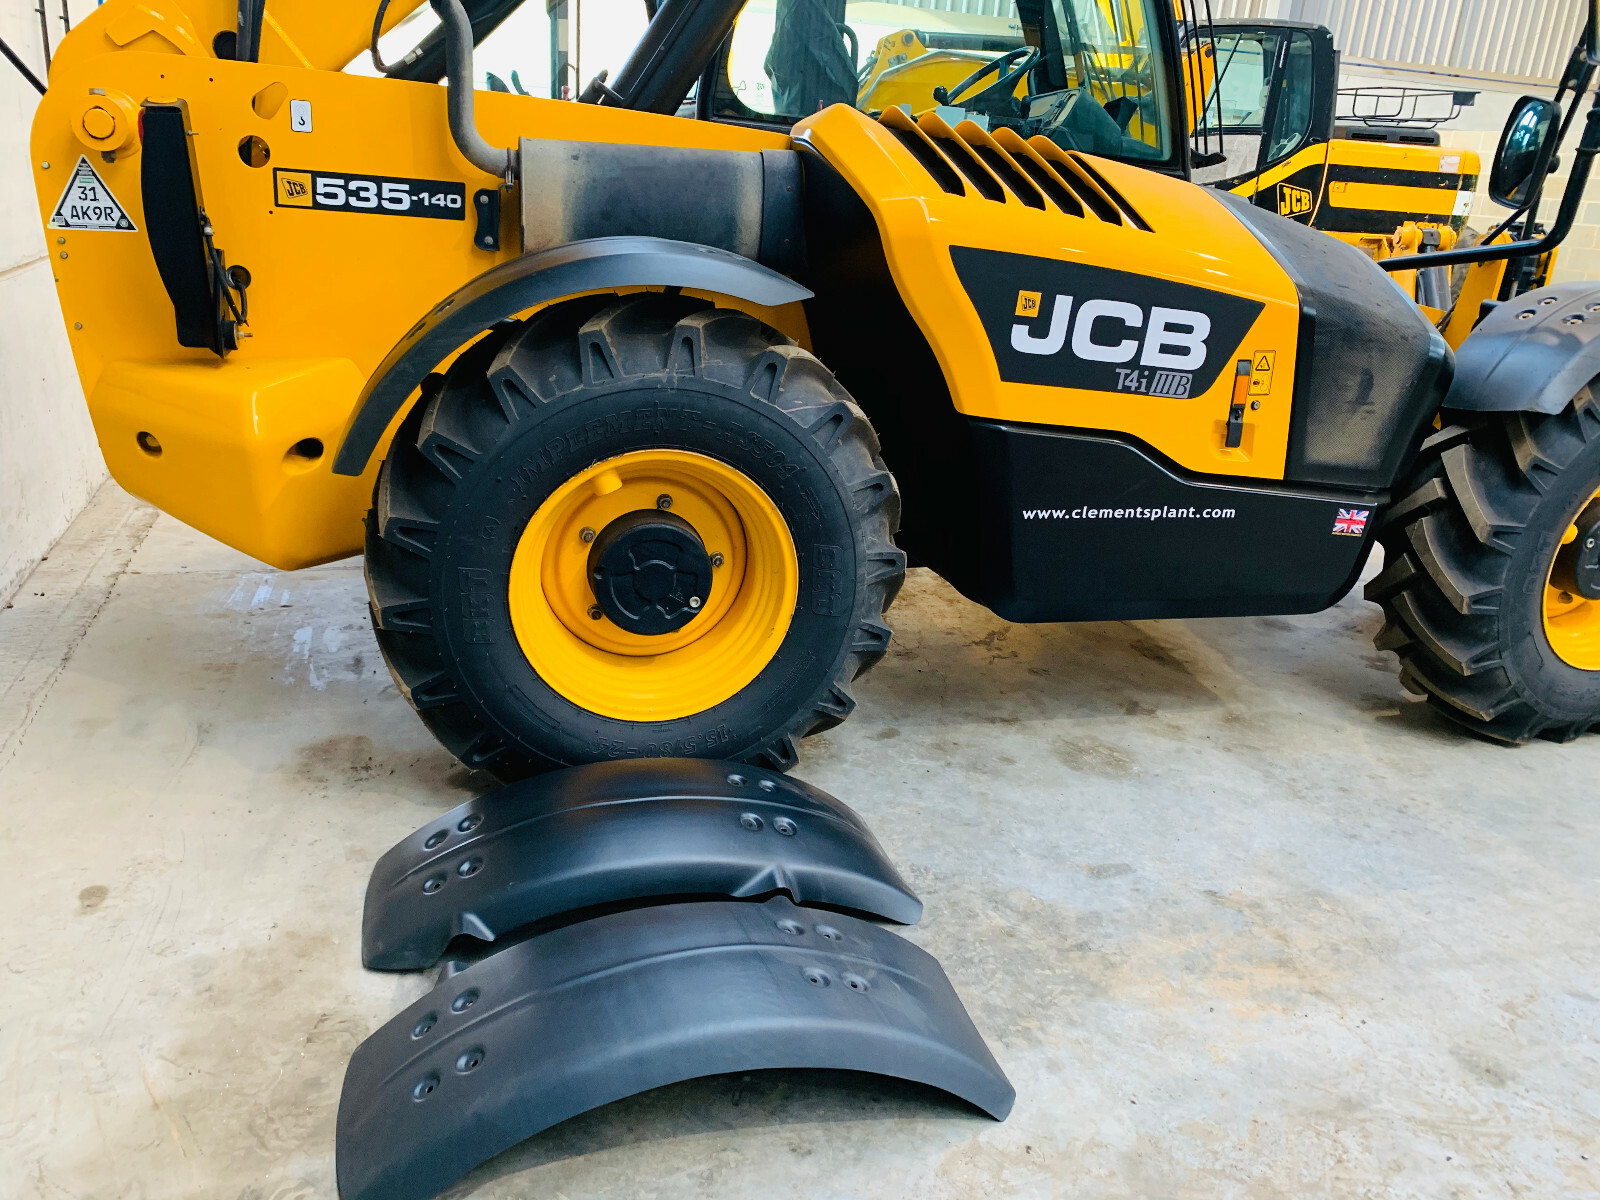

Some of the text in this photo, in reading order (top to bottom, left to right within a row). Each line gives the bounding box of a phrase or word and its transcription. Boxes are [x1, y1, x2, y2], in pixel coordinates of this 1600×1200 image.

[77, 185, 99, 202] 31
[286, 177, 462, 210] JCB 535-140
[1280, 186, 1310, 215] JCB
[70, 205, 115, 221] AK9R
[1023, 297, 1036, 310] JCB
[1010, 294, 1211, 370] JCB
[1022, 506, 1236, 521] www.clementsplant.com
